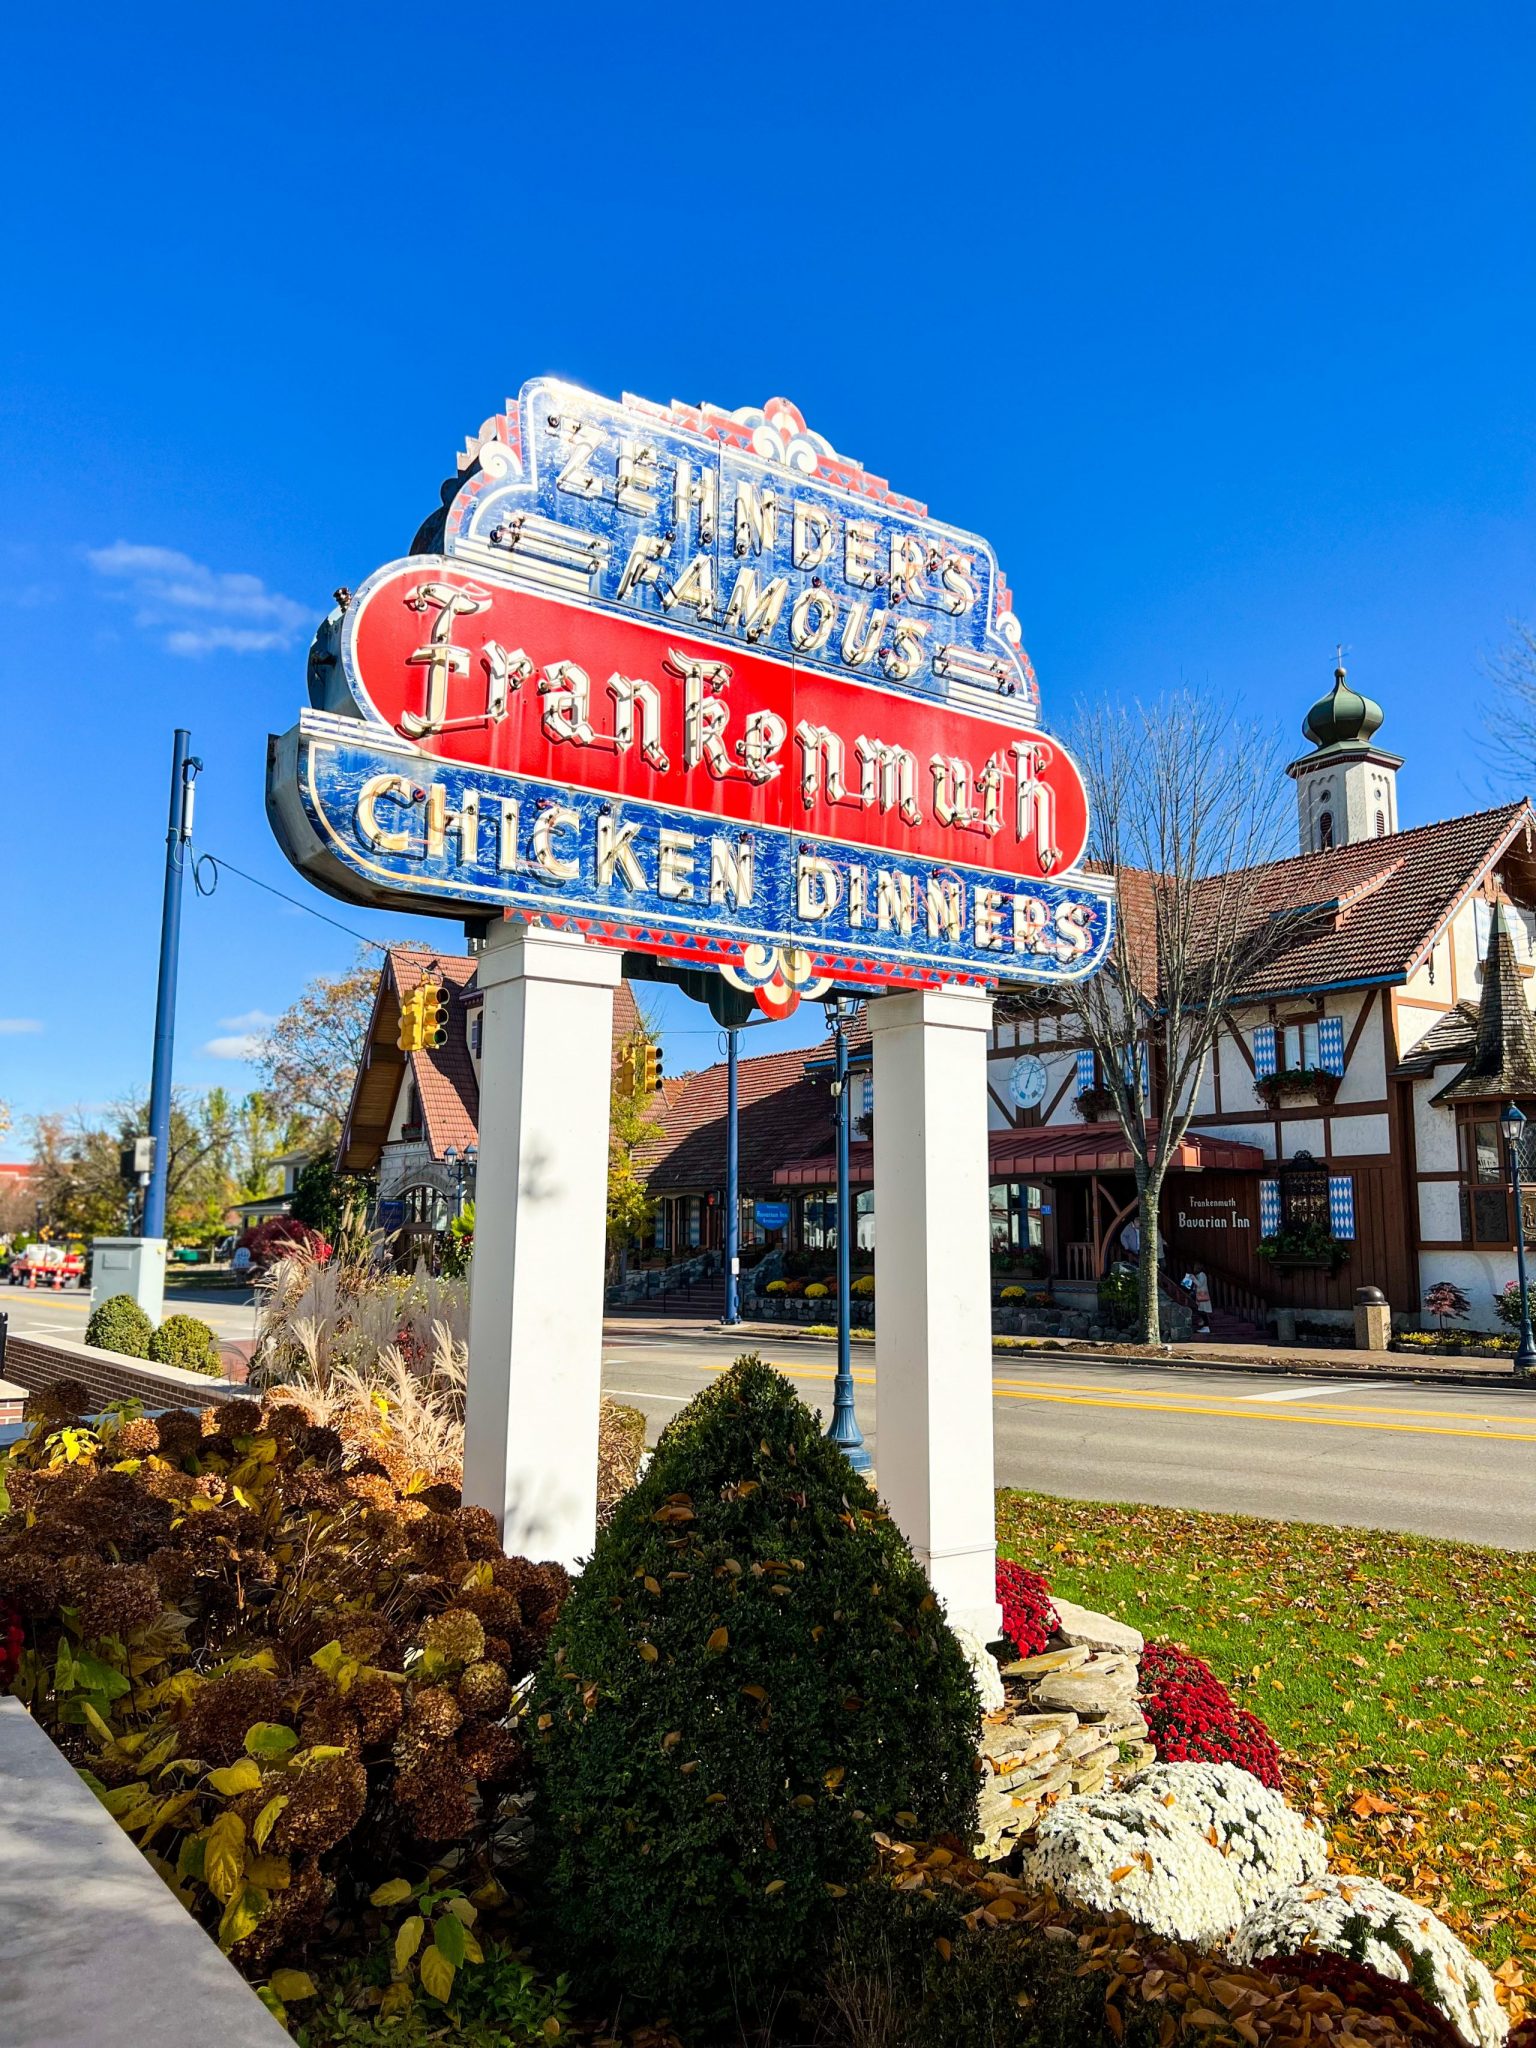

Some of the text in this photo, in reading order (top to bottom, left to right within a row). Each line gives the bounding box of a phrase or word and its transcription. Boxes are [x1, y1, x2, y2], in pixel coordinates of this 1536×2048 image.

[553, 415, 980, 617] ZEHNDER'S
[616, 533, 932, 681] FAMOUS
[400, 581, 1063, 873] Frankenmuth
[356, 773, 1097, 961] CHICKEN DINNERS
[1178, 1210, 1250, 1228] Bavarian Inn
[1189, 1196, 1236, 1207] Frankenmuth
